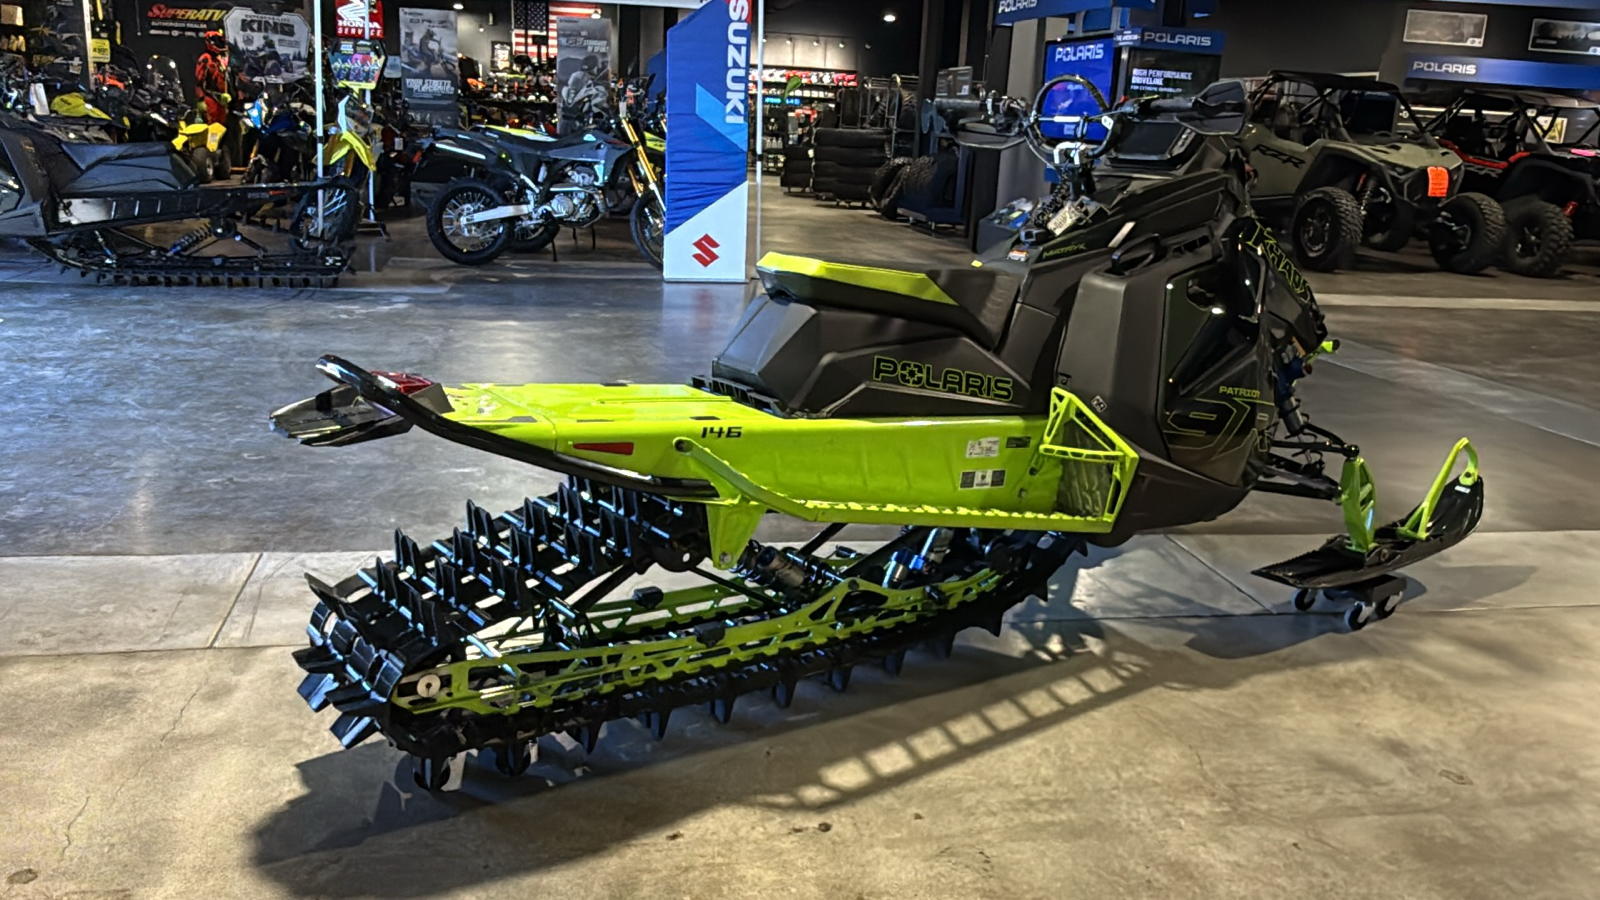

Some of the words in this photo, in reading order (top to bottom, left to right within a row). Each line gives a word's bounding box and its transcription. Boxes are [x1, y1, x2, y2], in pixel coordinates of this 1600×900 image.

[997, 0, 1037, 13] POLARIS
[240, 19, 295, 37] KING
[337, 20, 381, 28] HONA
[337, 27, 384, 36] SERVCE
[1143, 31, 1212, 46] POLARIS
[1055, 43, 1104, 62] POLARIS
[725, 0, 748, 124] SUZUKI
[1412, 60, 1477, 75] POLARIS
[1148, 69, 1193, 80] PERFORMANCE
[1253, 144, 1306, 168] RZR
[872, 355, 1014, 402] POLARIS
[1219, 386, 1260, 398] PATRIOT
[701, 426, 743, 439] 146
